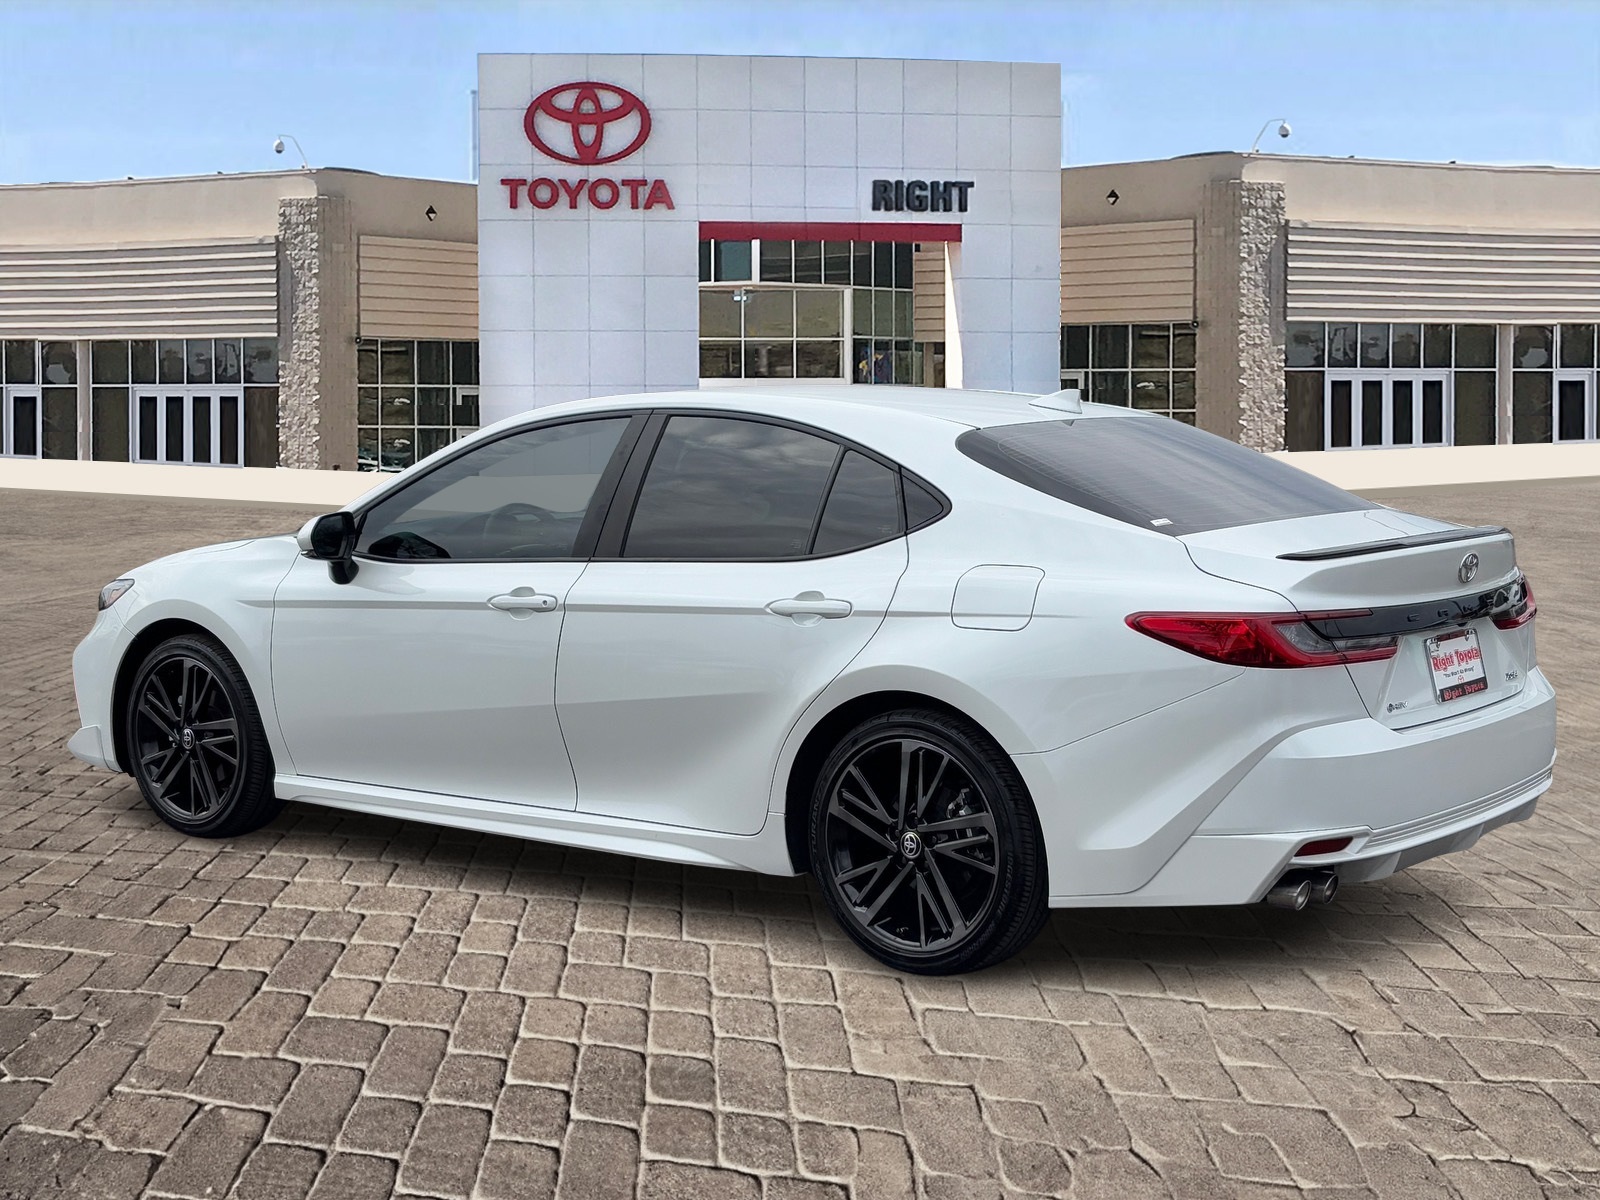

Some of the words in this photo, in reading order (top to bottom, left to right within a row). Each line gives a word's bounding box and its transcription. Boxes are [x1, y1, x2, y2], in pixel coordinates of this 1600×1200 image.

[500, 178, 675, 210] TOYOTA
[871, 179, 975, 213] RIGHT
[1431, 653, 1455, 672] Right
[1455, 648, 1481, 666] Toyota
[1443, 688, 1463, 700] Right
[1464, 682, 1485, 695] Toyota
